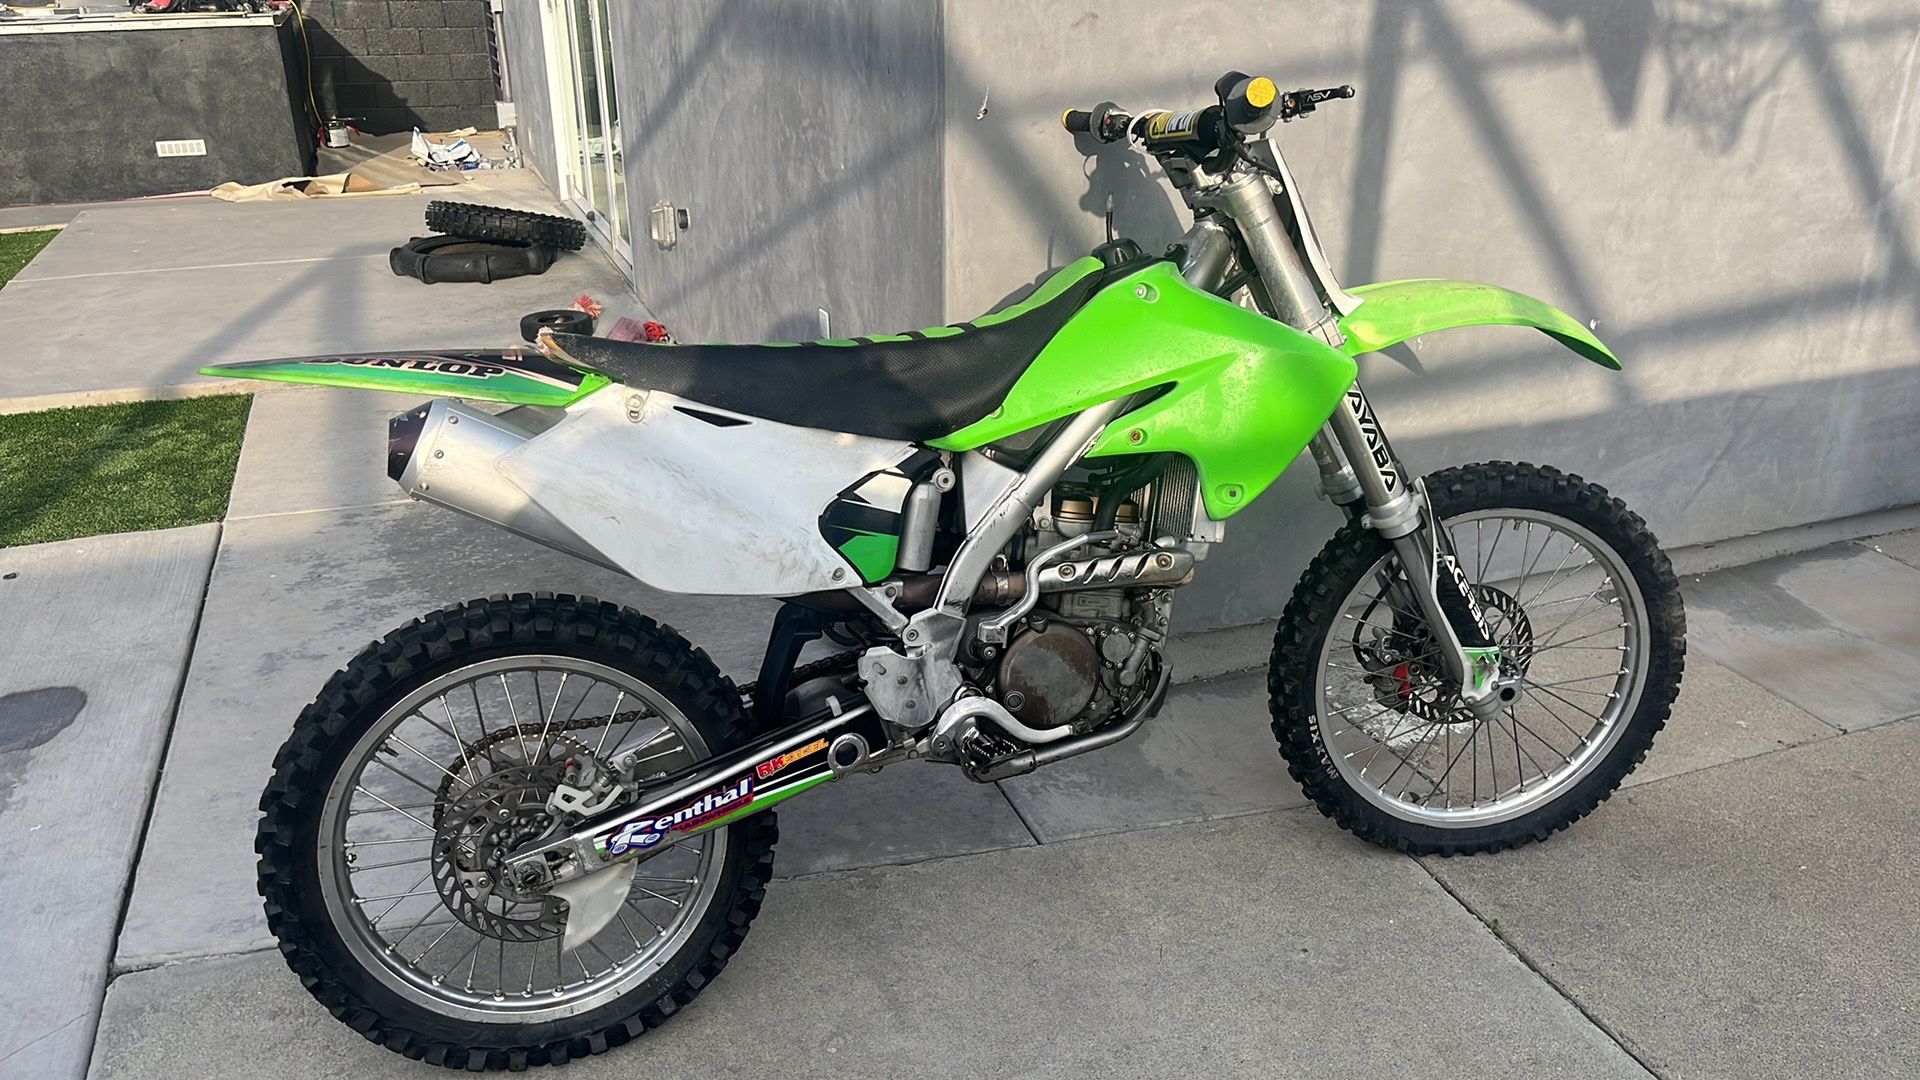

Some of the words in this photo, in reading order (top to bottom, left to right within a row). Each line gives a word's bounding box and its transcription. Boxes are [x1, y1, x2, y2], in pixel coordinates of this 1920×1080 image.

[1307, 90, 1331, 103] ASV
[1346, 390, 1397, 493] AYABA
[609, 778, 751, 854] Renthal
